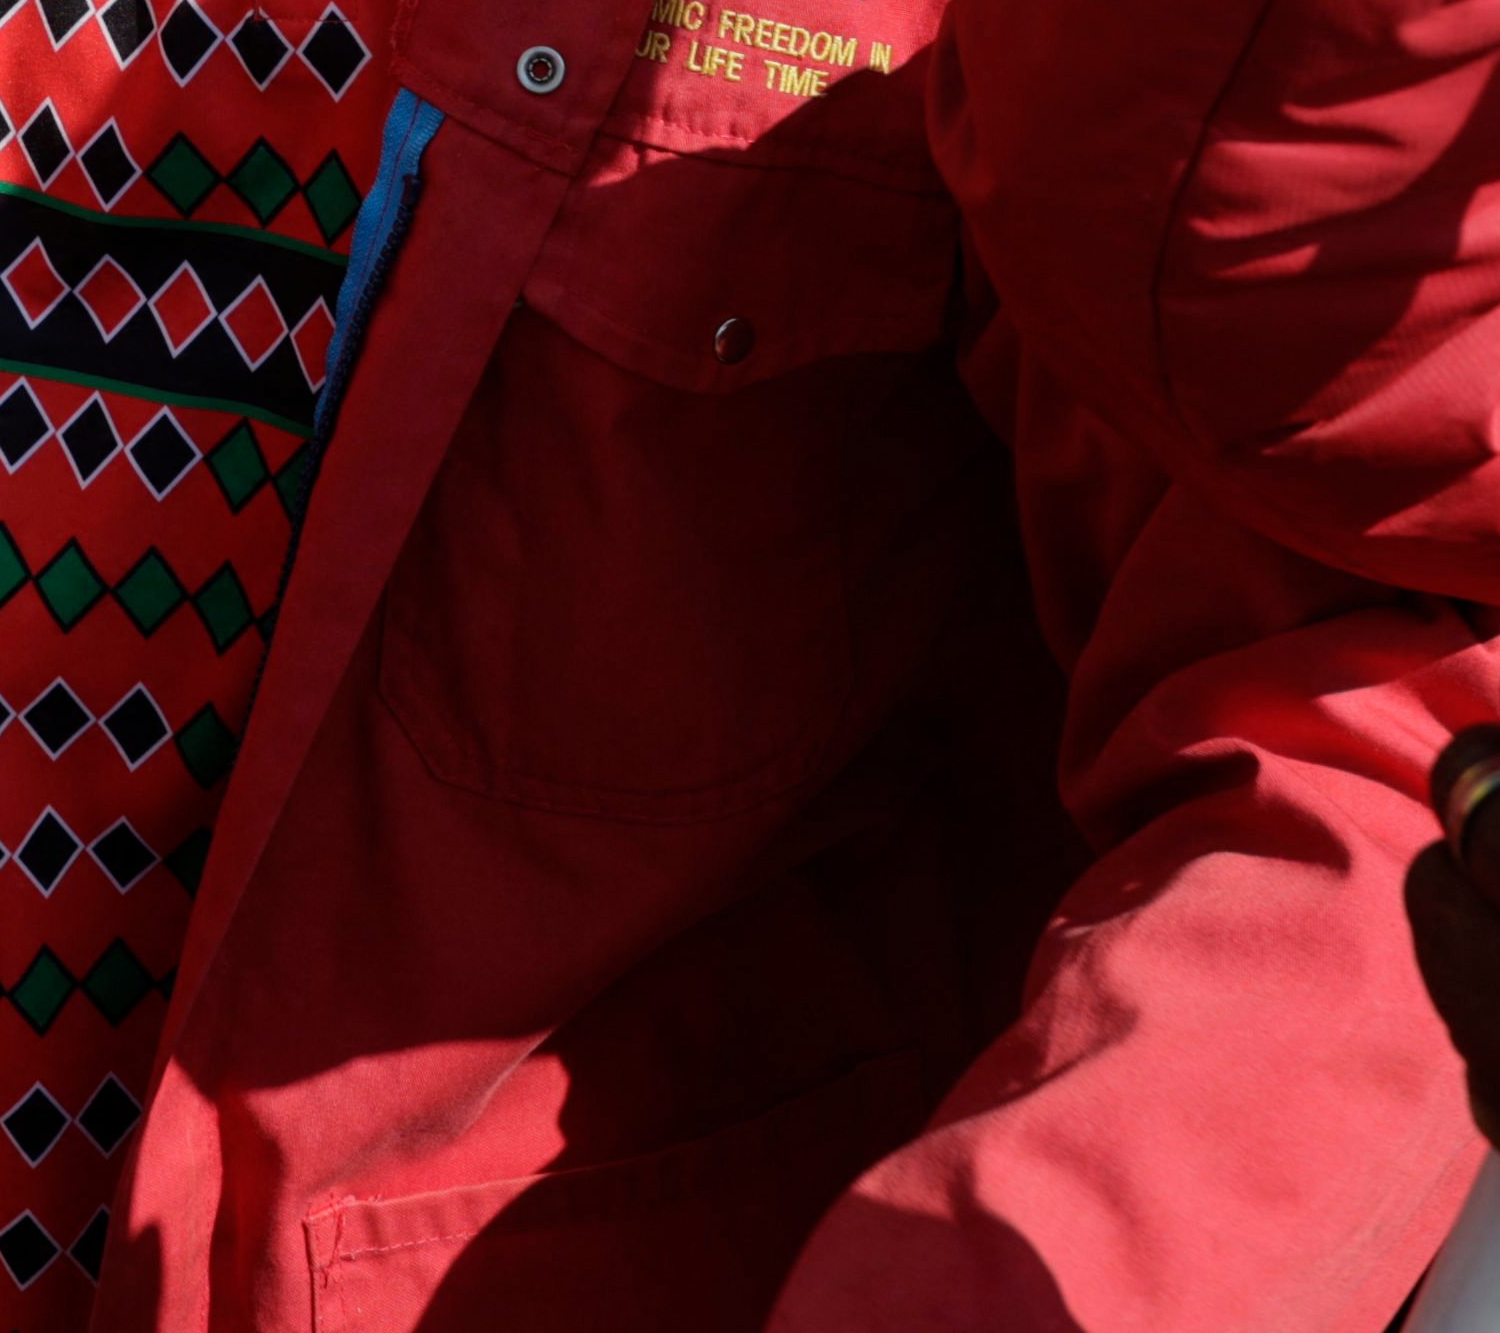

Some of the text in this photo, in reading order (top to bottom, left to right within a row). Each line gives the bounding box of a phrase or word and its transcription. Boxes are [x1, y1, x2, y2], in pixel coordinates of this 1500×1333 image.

[686, 41, 745, 82] LIFE
[763, 59, 830, 98] TIME
[718, 9, 858, 67] FREEDOM
[869, 42, 893, 75] IN
